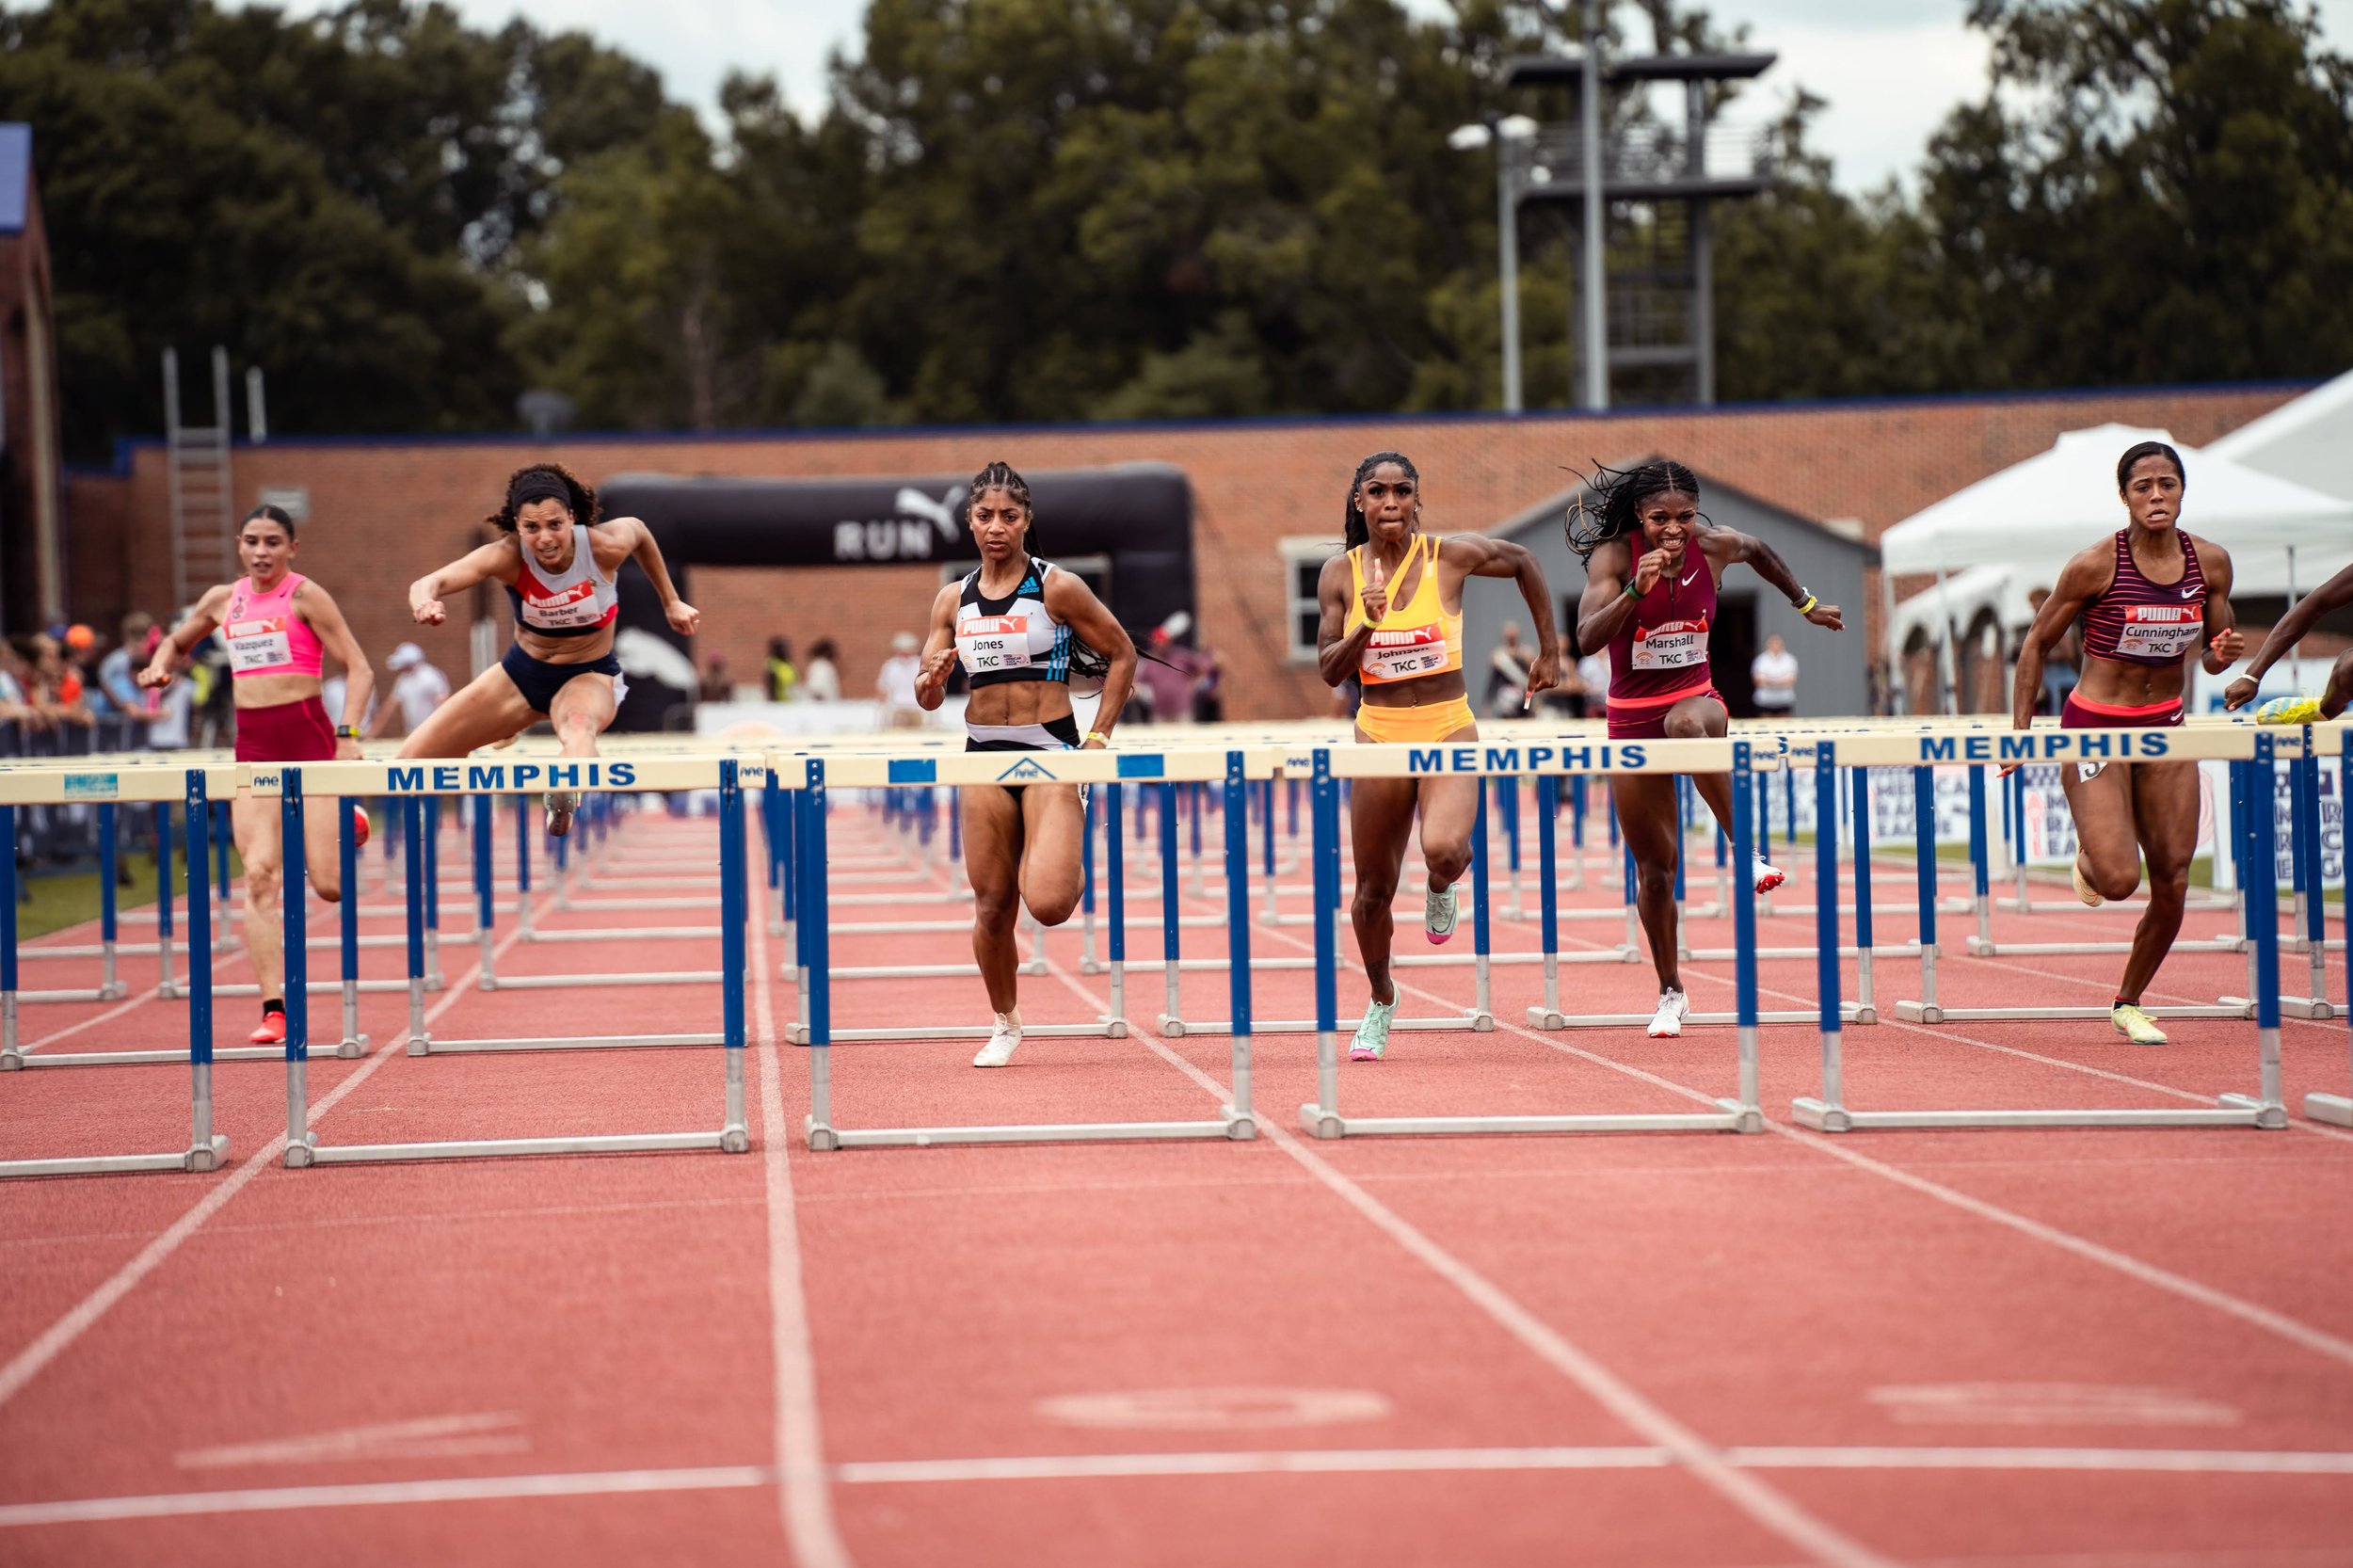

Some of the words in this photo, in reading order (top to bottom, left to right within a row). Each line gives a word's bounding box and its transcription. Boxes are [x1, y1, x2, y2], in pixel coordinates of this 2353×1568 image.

[835, 520, 933, 560] RUN
[1017, 586, 1039, 595] adidas
[539, 607, 578, 616] Barber
[2137, 607, 2182, 621] PUMA
[963, 617, 1000, 634] PUMA
[1370, 631, 1415, 646] PUMA
[2126, 627, 2200, 639] Cunningham
[973, 640, 1003, 650] Jones
[1646, 634, 1693, 648] Marshall
[2148, 643, 2171, 653] TKC
[977, 656, 1000, 667] TKC
[1659, 654, 1682, 664] TKC
[1392, 660, 1417, 673] TKC
[1920, 732, 2169, 760] MEMPHIS
[1409, 744, 1647, 772] MEMPHIS
[388, 762, 636, 792] MEMPHIS
